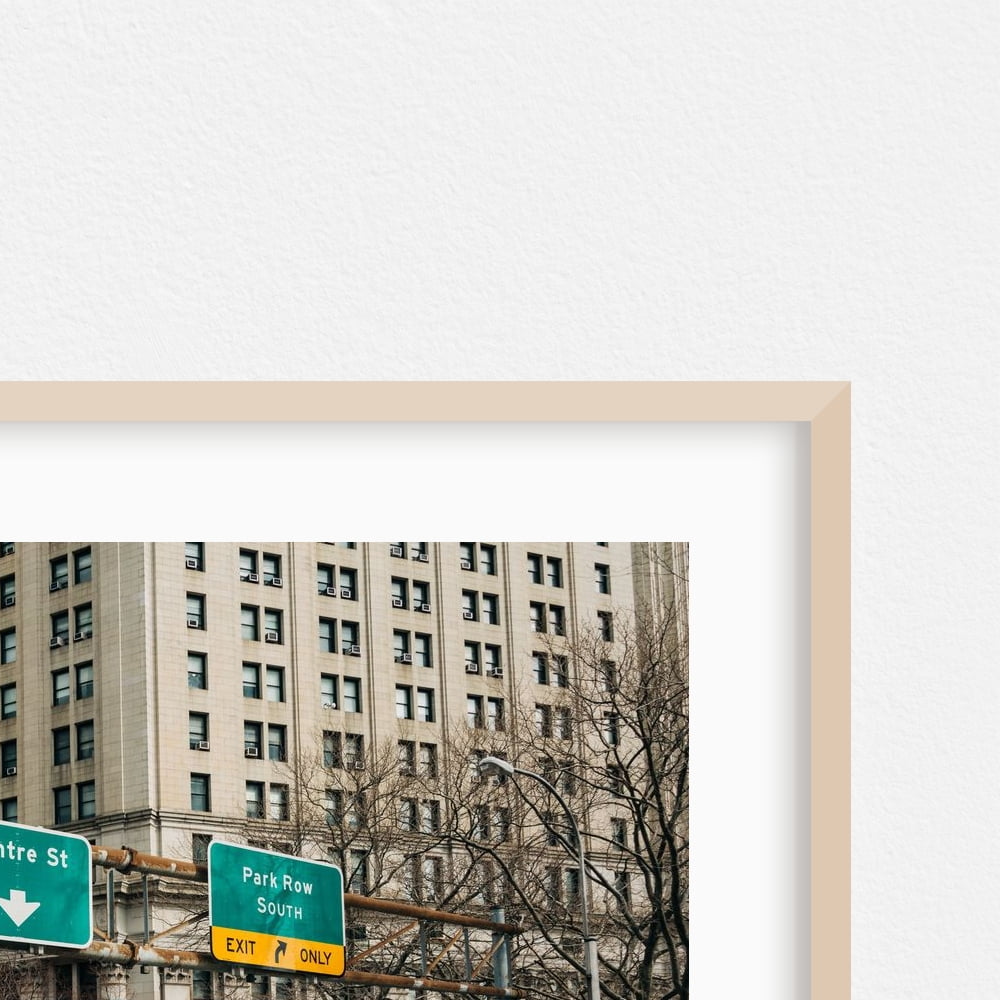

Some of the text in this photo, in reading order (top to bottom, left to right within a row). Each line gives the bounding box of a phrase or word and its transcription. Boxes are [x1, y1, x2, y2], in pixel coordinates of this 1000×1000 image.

[47, 847, 69, 868] St
[242, 866, 313, 895] Park Row
[257, 897, 303, 920] SOUTH
[226, 937, 333, 965] EXIT ONLY
